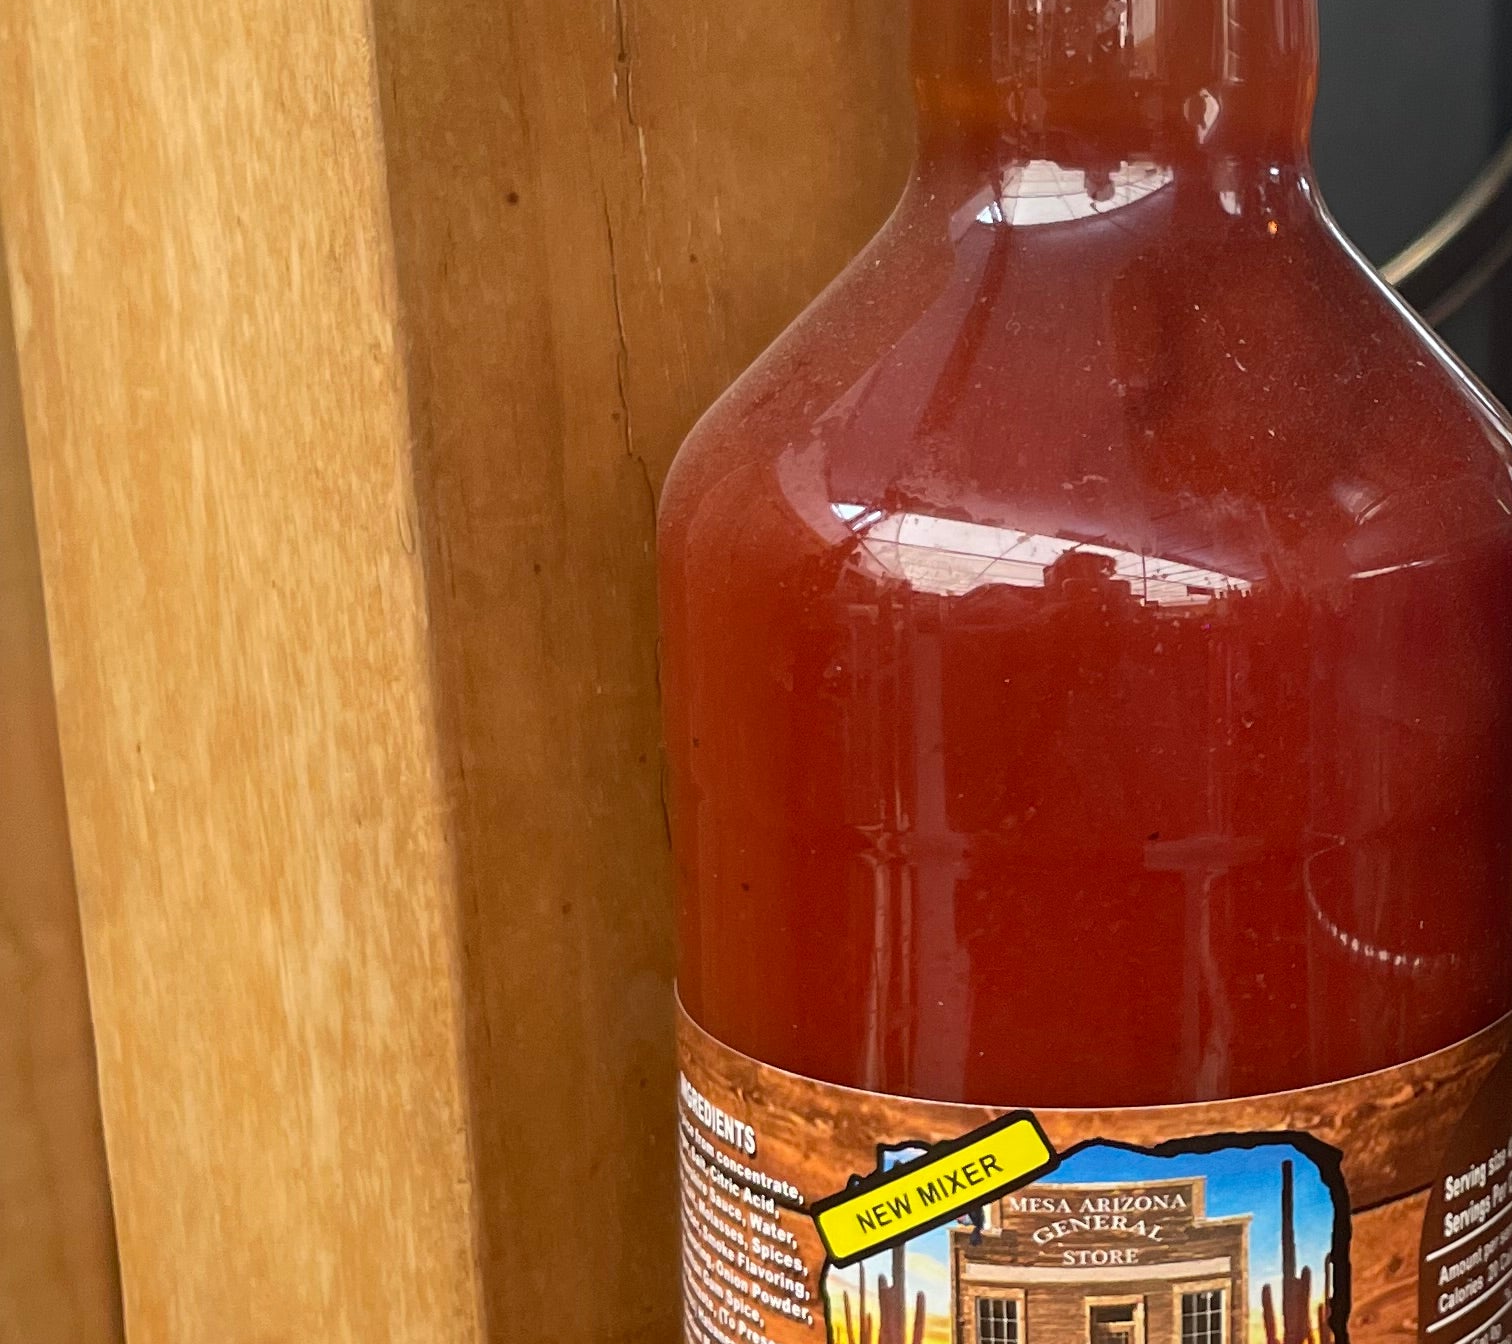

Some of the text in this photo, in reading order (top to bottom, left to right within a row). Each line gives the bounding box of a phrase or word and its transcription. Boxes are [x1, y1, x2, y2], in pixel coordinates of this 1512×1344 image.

[709, 1165, 740, 1197] Citric
[742, 1186, 780, 1219] Acid,
[715, 1150, 804, 1206] concentrate,
[856, 1153, 1003, 1234] NEW MIXER
[1444, 1160, 1487, 1202] Serving
[709, 1186, 747, 1227] Sauce,
[749, 1212, 798, 1250] Water,
[1009, 1193, 1188, 1215] MESA ARIZONA
[1443, 1194, 1491, 1239] Servings
[1032, 1214, 1163, 1246] GENERAL
[737, 1251, 810, 1301] Flavoring,
[751, 1236, 808, 1277] Spices,
[1063, 1248, 1139, 1266] STORE
[715, 1259, 748, 1294] Onion
[750, 1282, 813, 1325] Powder,
[725, 1289, 765, 1328] Spice,
[1437, 1274, 1485, 1314] Calories
